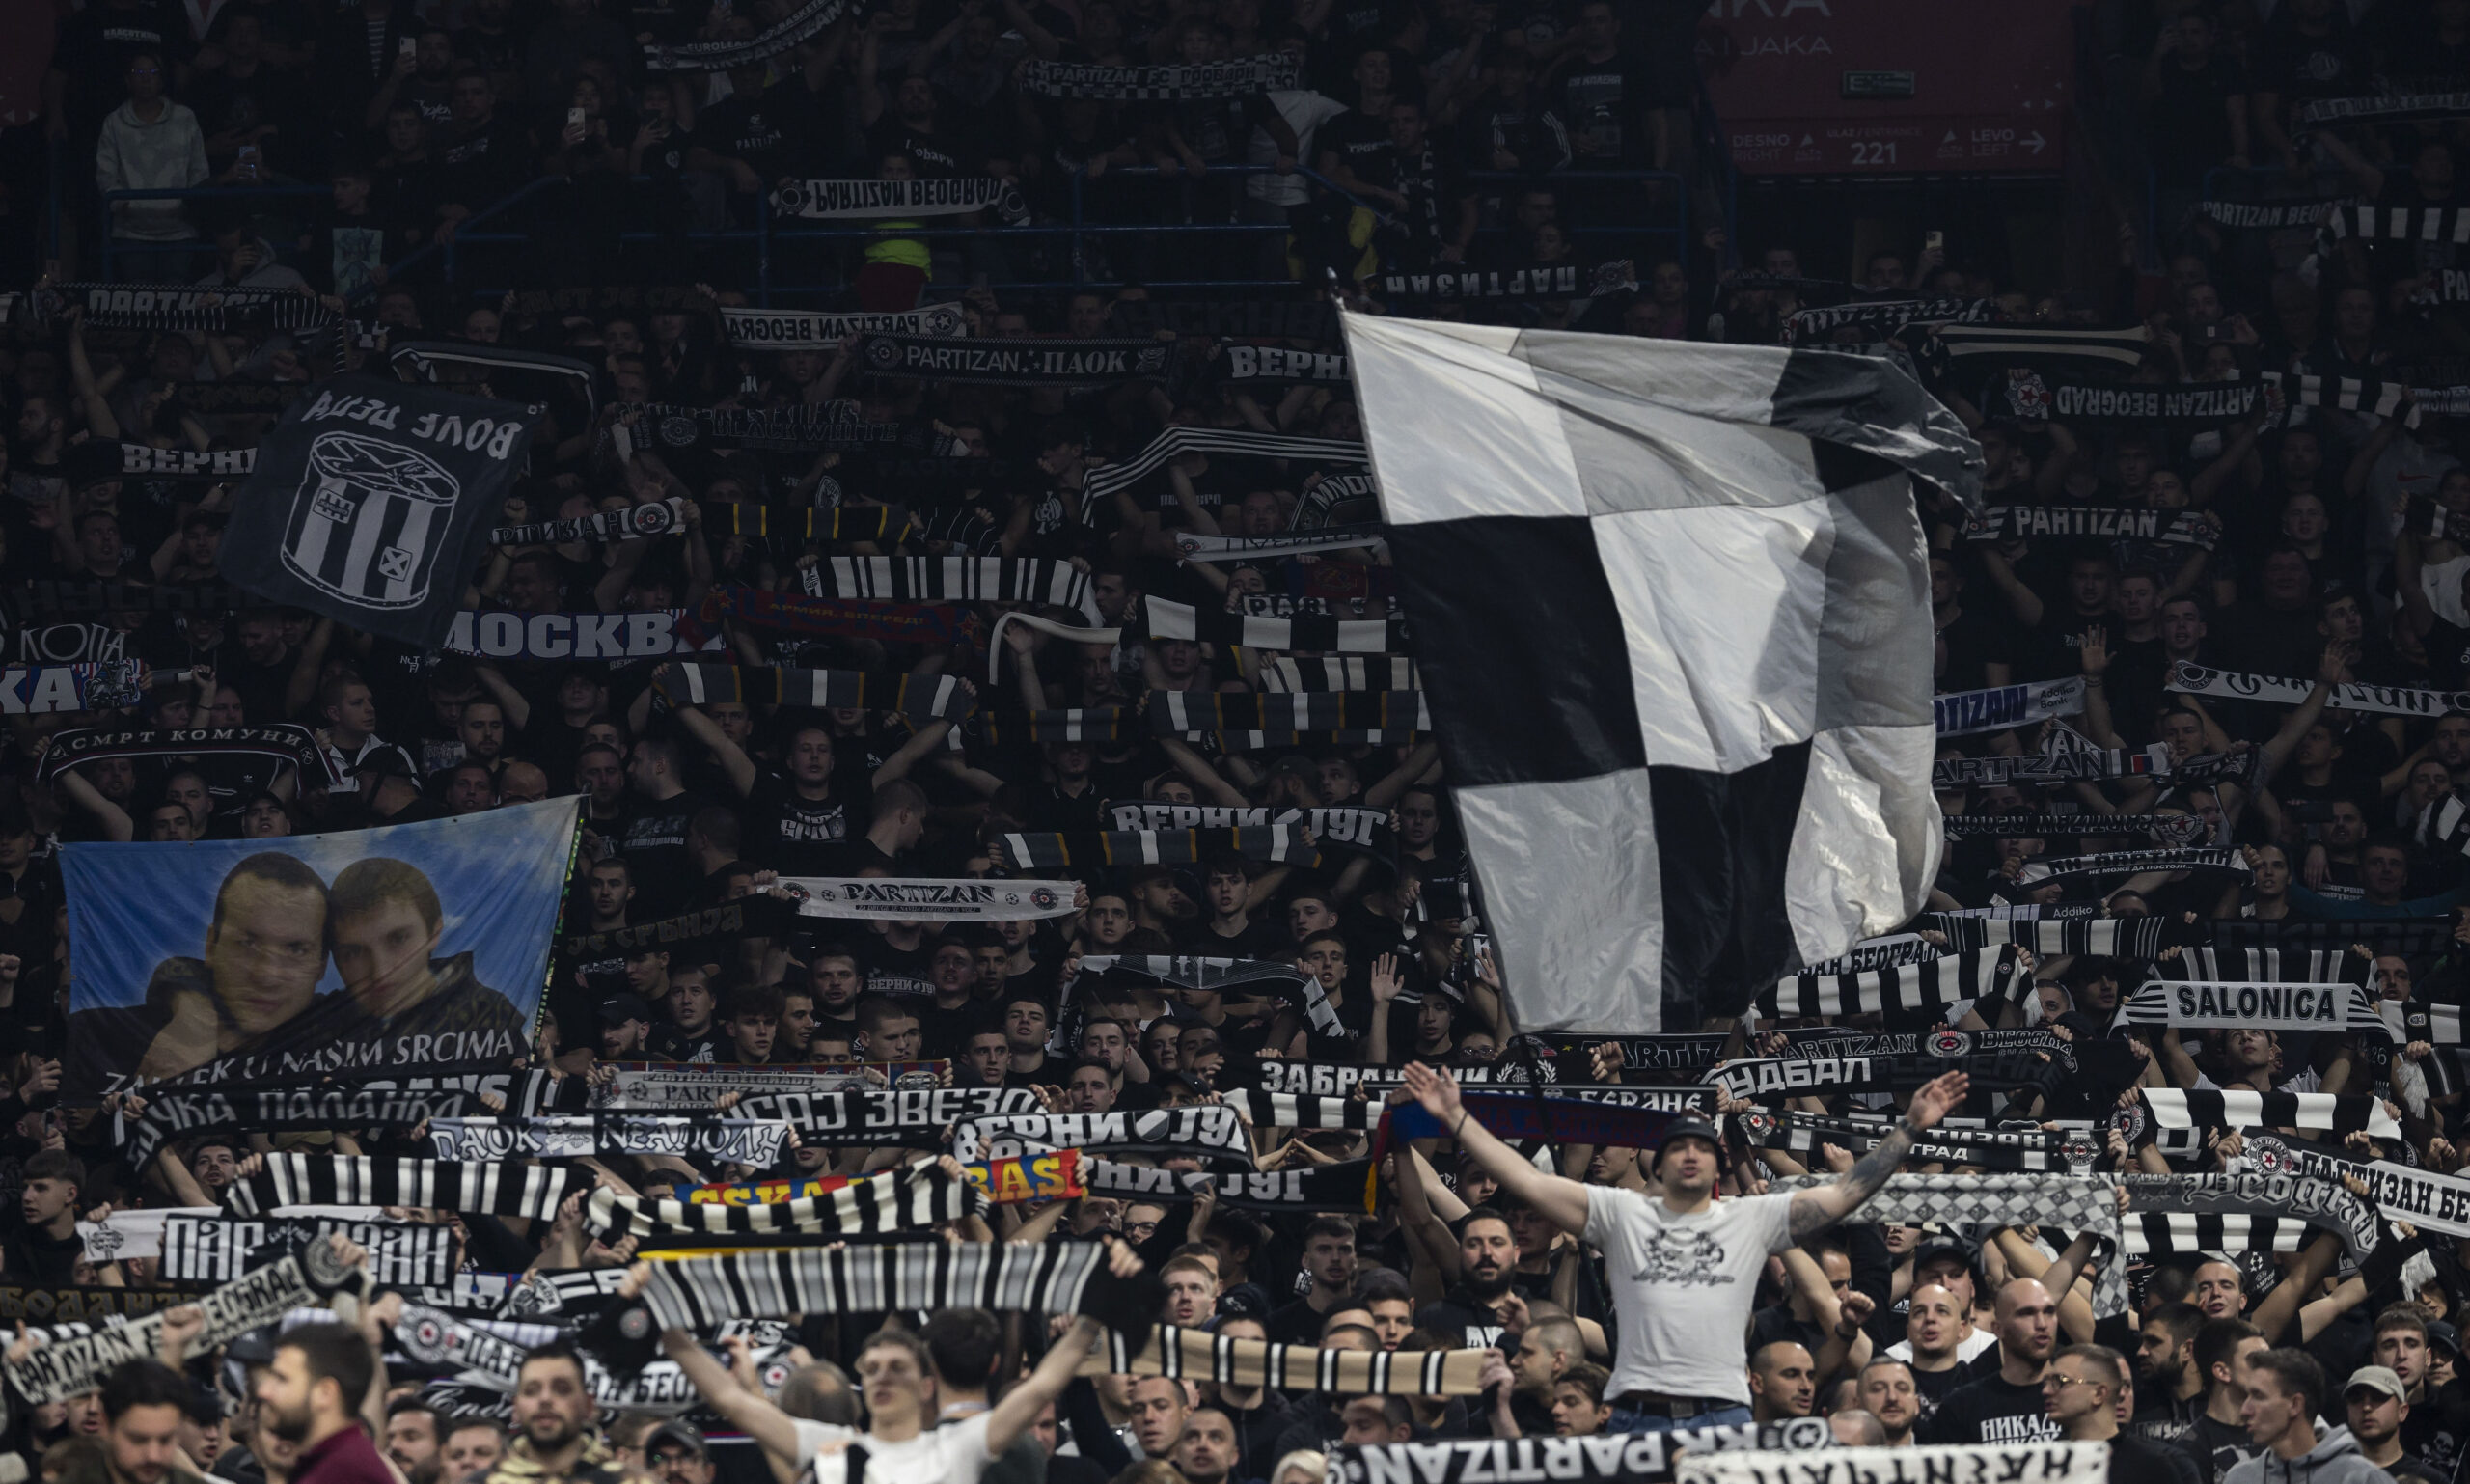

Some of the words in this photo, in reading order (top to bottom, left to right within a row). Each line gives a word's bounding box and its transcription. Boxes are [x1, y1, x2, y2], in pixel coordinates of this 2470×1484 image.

[1740, 36, 1832, 55] JAKA
[1053, 68, 1139, 85] PARTIZAN
[1732, 134, 1792, 148] DESNO
[1970, 128, 2015, 142] LEVO
[1851, 141, 1897, 165] 221
[1970, 143, 2009, 156] LEFT
[1385, 265, 1576, 296] ПАРТИЗАН
[906, 345, 1020, 372] PARTIZAN
[2056, 385, 2159, 418] BEOGRAD
[2014, 507, 2159, 539] PARTIZAN
[443, 611, 726, 659] ОСКВ
[2040, 685, 2076, 699] Addiko
[2040, 696, 2069, 709] Bank
[71, 728, 155, 749] СМРТ
[2101, 866, 2130, 875] МОЖЕ
[840, 883, 996, 904] PARTIZAN
[2052, 906, 2093, 919] Addiko
[2178, 985, 2337, 1022] SALONICA
[392, 1028, 515, 1067] SRCIMA
[1217, 1167, 1316, 1202] ЈУГ
[1360, 1429, 1666, 1484] PARTIZAN
